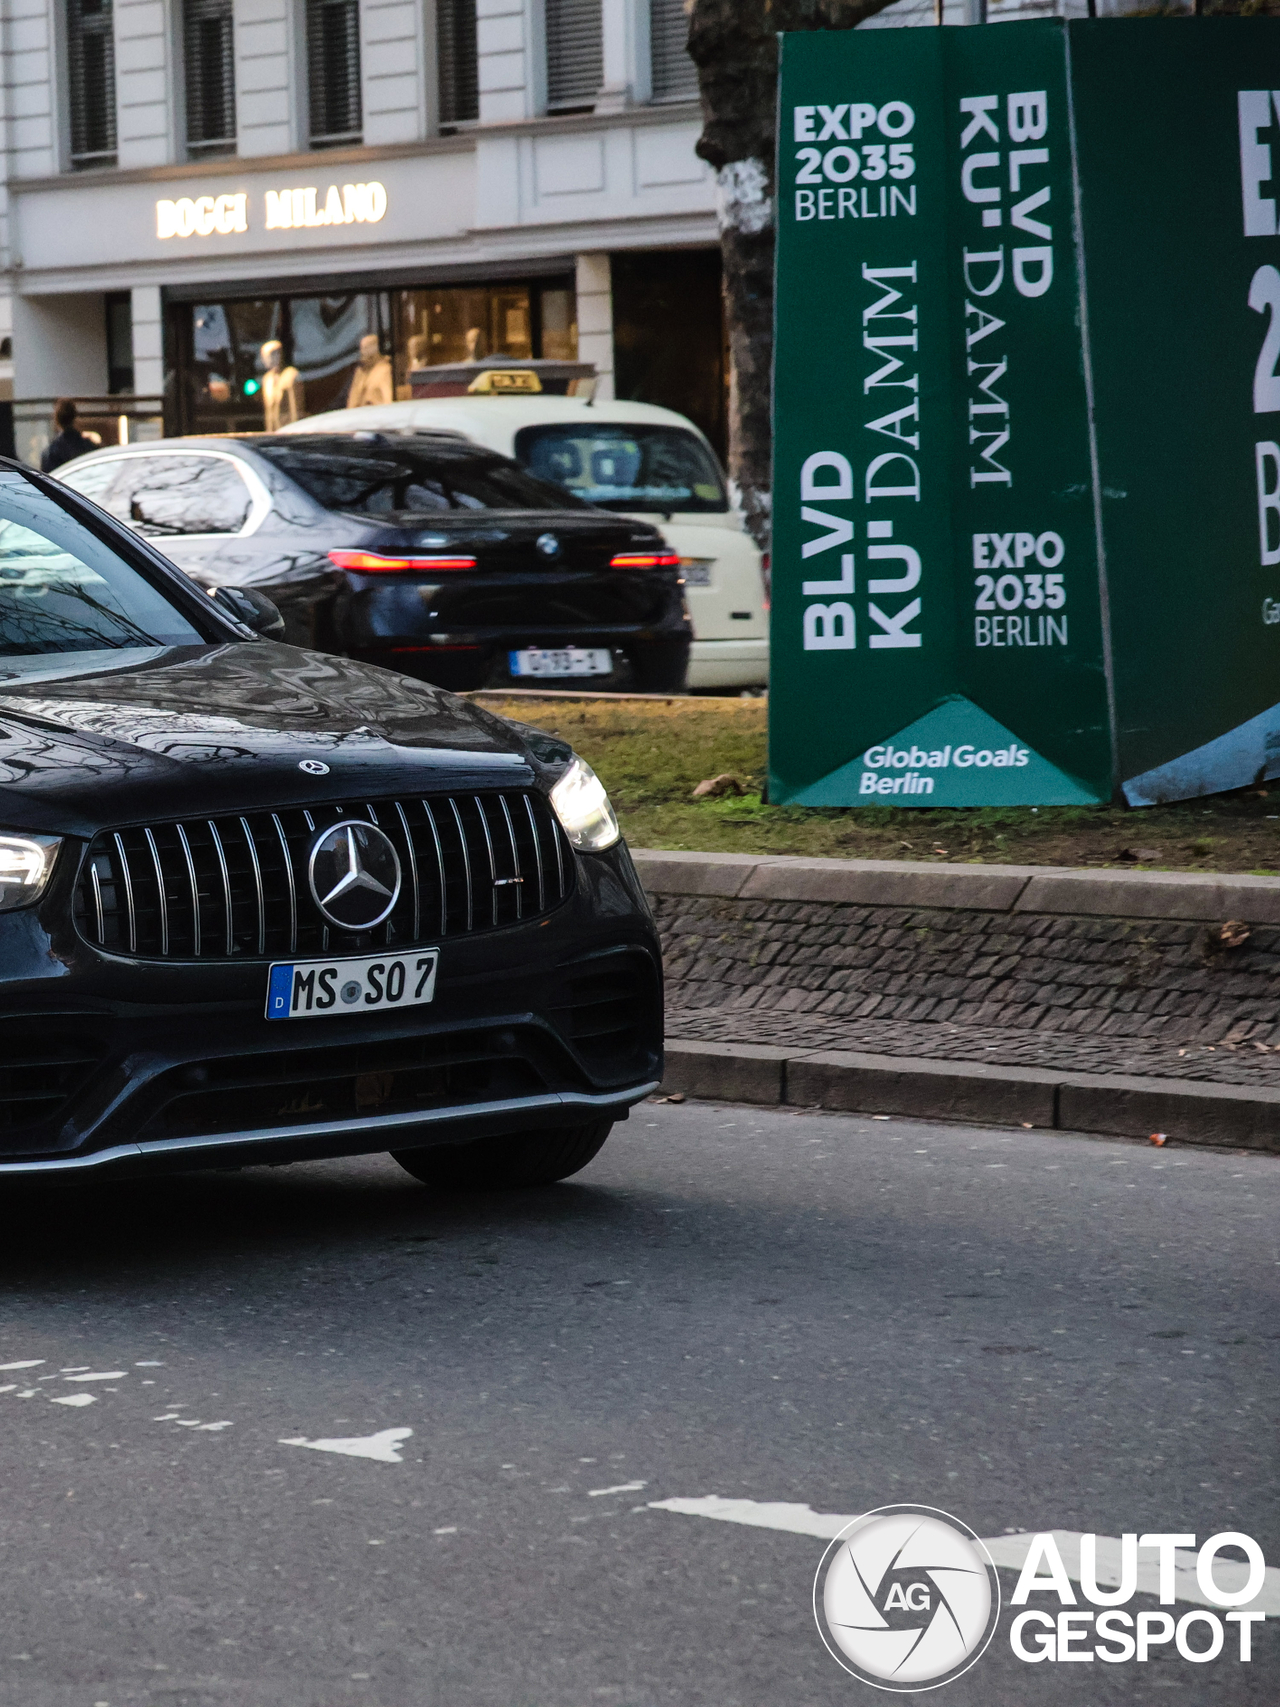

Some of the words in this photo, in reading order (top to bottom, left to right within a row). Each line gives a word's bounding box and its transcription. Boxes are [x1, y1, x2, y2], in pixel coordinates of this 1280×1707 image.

[794, 101, 915, 142] EXPO
[795, 143, 915, 184] 2035
[156, 193, 248, 239] BOGGI
[265, 181, 388, 230] MILANO
[795, 185, 916, 221] BERLIN
[1007, 90, 1053, 297] BLVD
[800, 451, 856, 650] BLVD
[973, 531, 1065, 569] EXPO
[974, 574, 1066, 611] 2035
[975, 615, 1068, 647] BERLIN
[863, 746, 950, 768] Global
[952, 744, 1030, 768] Goals
[859, 772, 934, 794] Berlin
[275, 997, 283, 1009] D
[292, 968, 338, 1011] MS
[415, 957, 434, 998] 7
